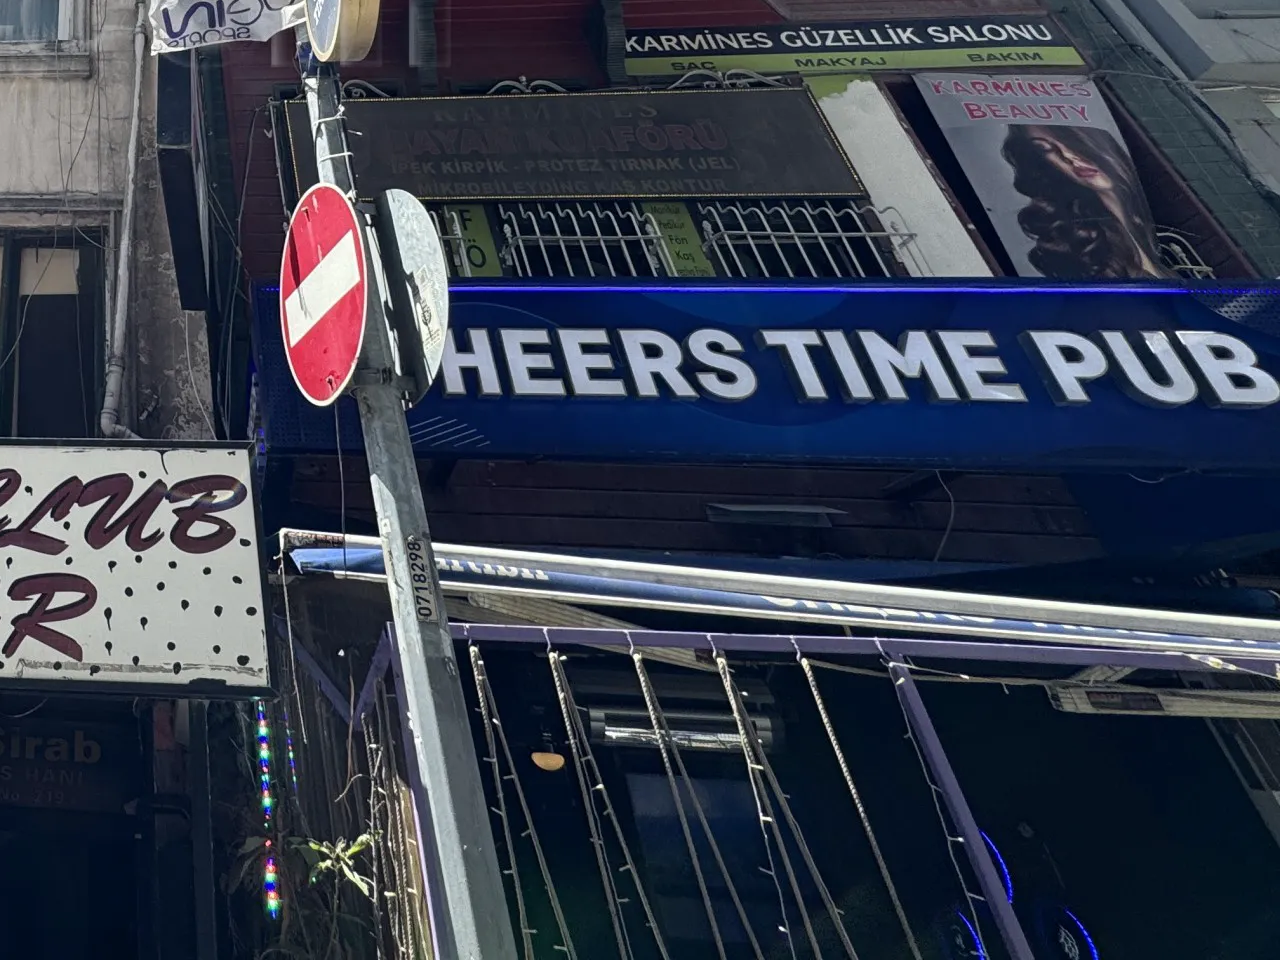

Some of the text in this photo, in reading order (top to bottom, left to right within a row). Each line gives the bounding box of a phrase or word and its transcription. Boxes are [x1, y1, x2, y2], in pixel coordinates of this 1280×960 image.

[927, 22, 1053, 45] SALONU
[793, 55, 888, 70] MAKYAJ
[968, 50, 1045, 65] BAKIM
[962, 101, 1090, 122] BEAUTY
[524, 158, 604, 174] PROTEZ
[640, 177, 731, 193] KONTUR
[441, 327, 1280, 409] HEERS TIME PUB
[407, 541, 433, 617] 0718298
